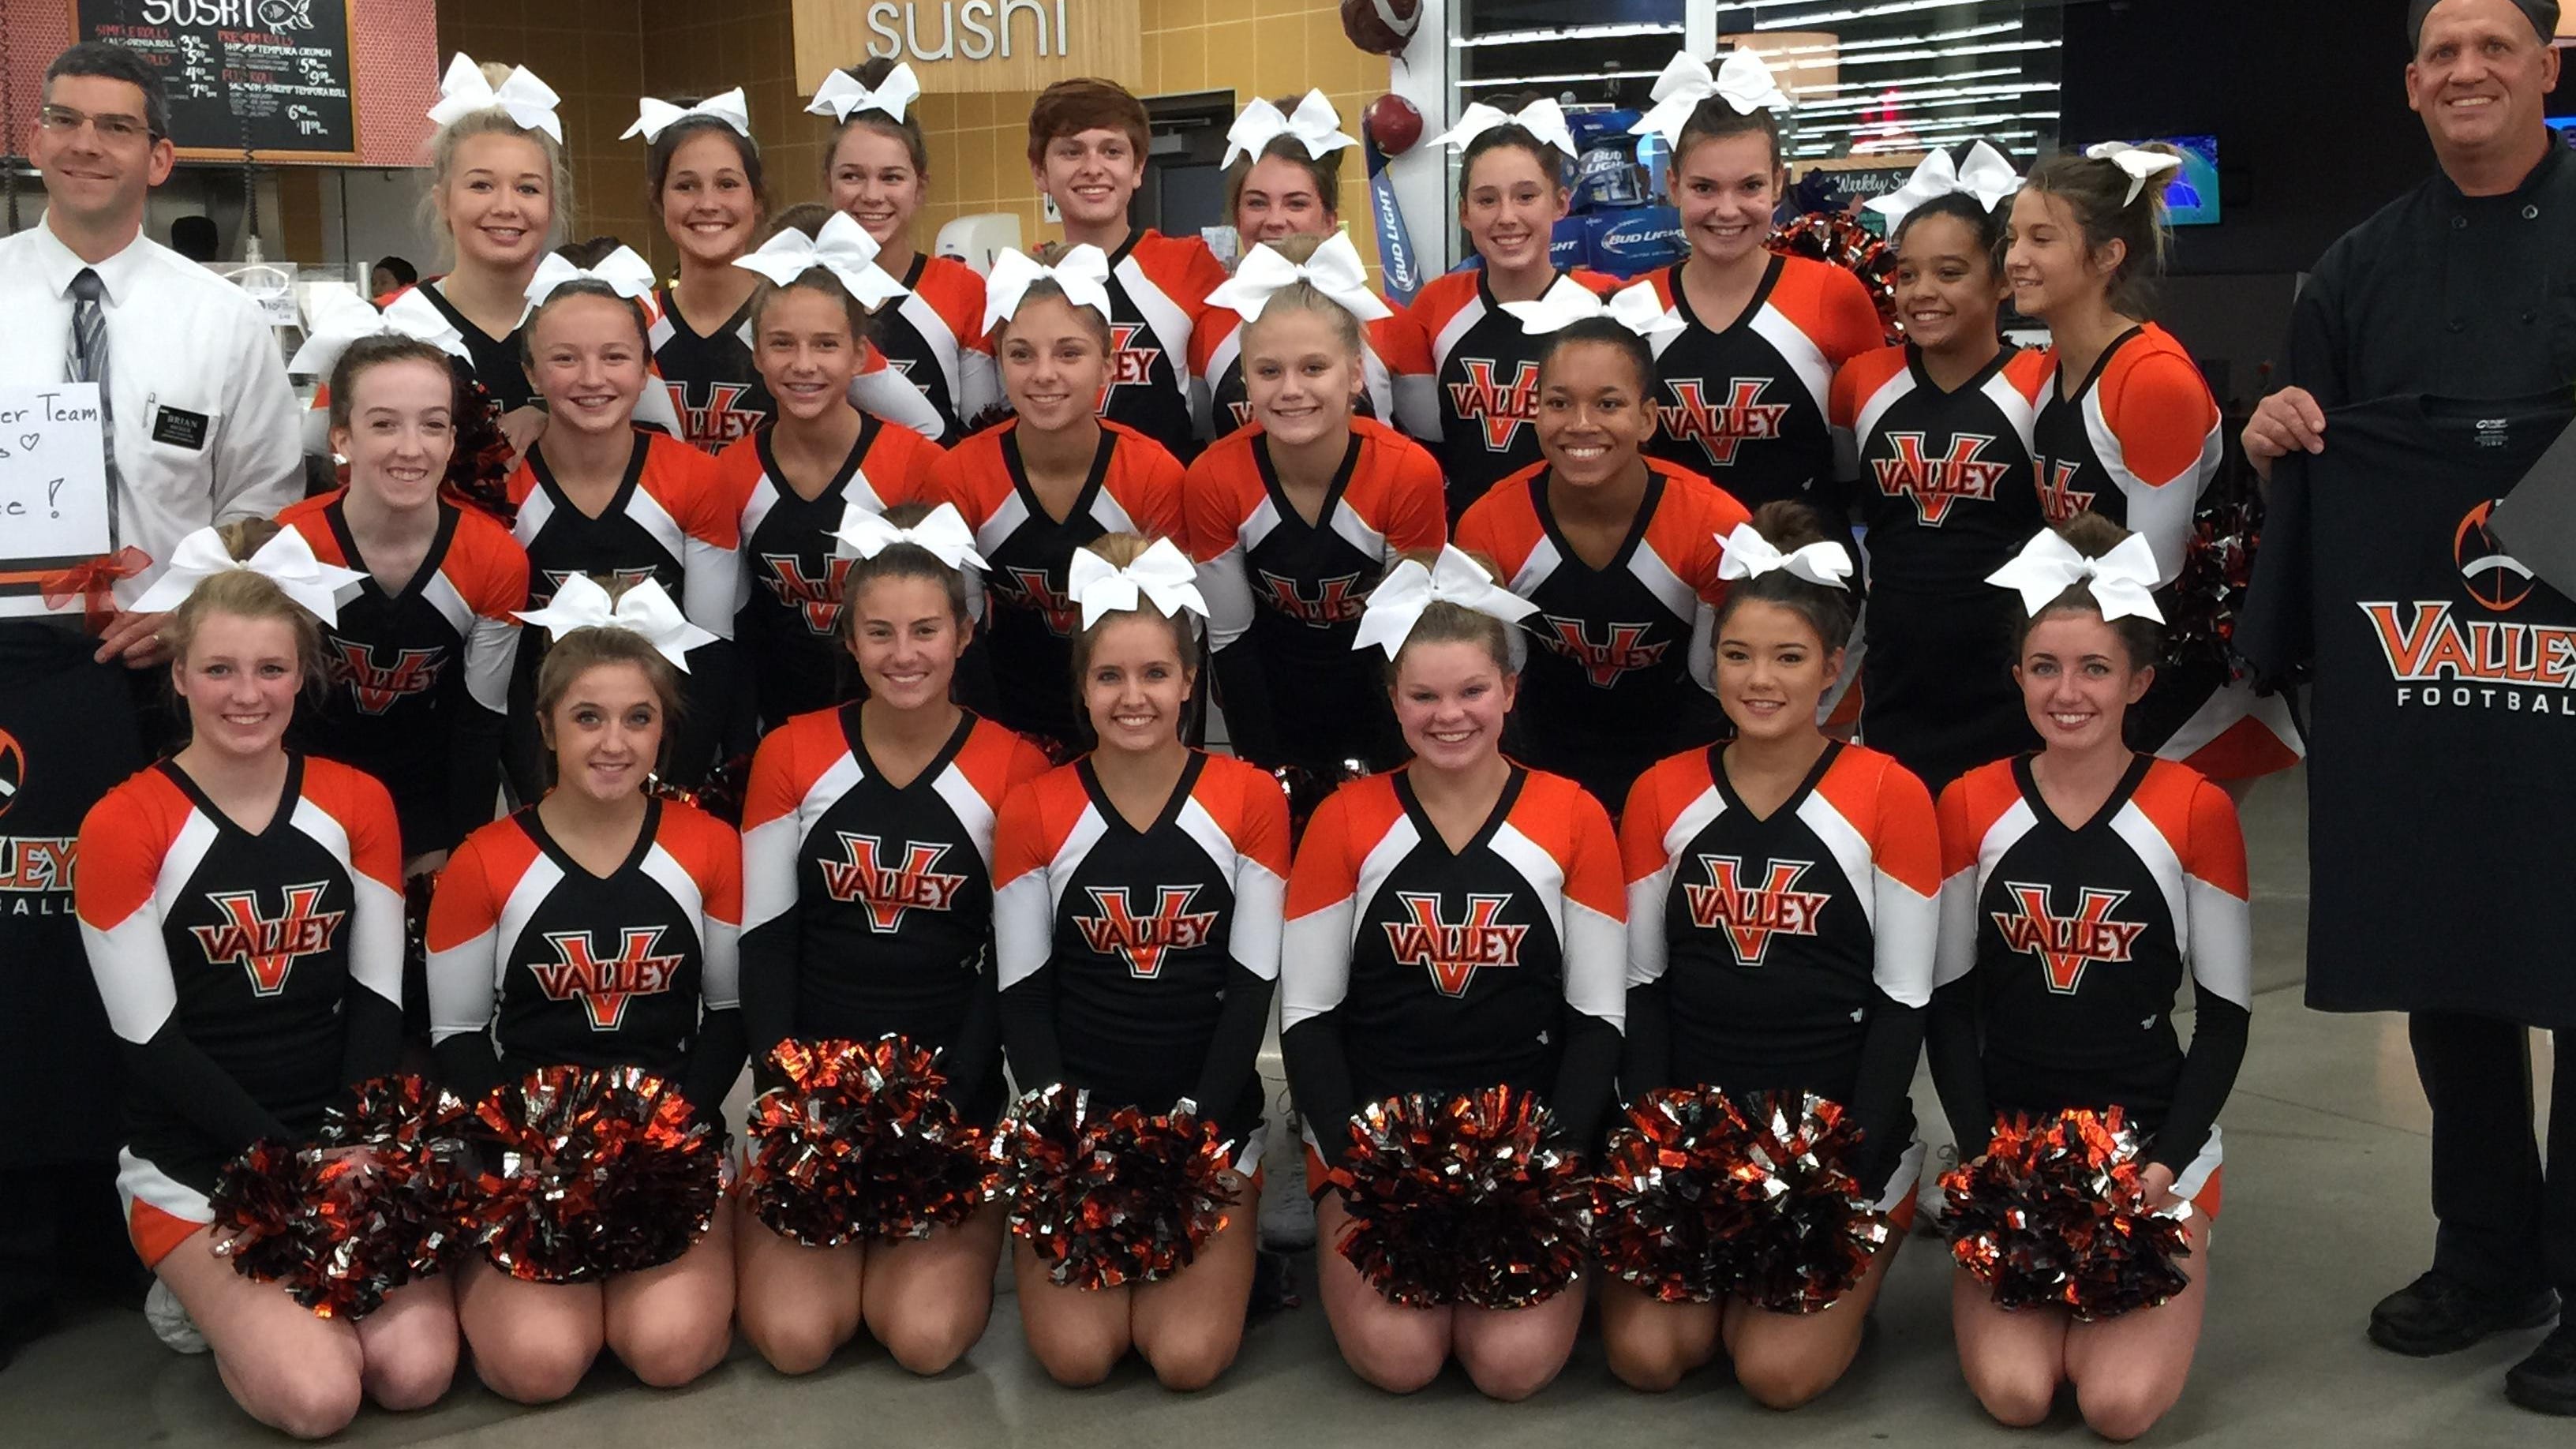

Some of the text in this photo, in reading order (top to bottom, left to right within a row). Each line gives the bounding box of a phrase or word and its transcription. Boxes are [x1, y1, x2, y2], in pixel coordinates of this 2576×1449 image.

[867, 0, 1067, 61] sushi
[36, 392, 98, 422] Team
[1447, 382, 1541, 423] VALLE
[1657, 403, 1792, 440] VALLEY
[1870, 459, 2012, 501] VALLEY
[2356, 601, 2576, 689] VALLE
[818, 858, 968, 911] VALLEY
[1071, 910, 1219, 954] VALLEY
[1683, 883, 1833, 936] VALLEY
[188, 910, 346, 964] VALLEY
[1381, 922, 1531, 966] VALLEY
[1990, 912, 2148, 962] VALLEY
[526, 953, 685, 1002] VALLEY
